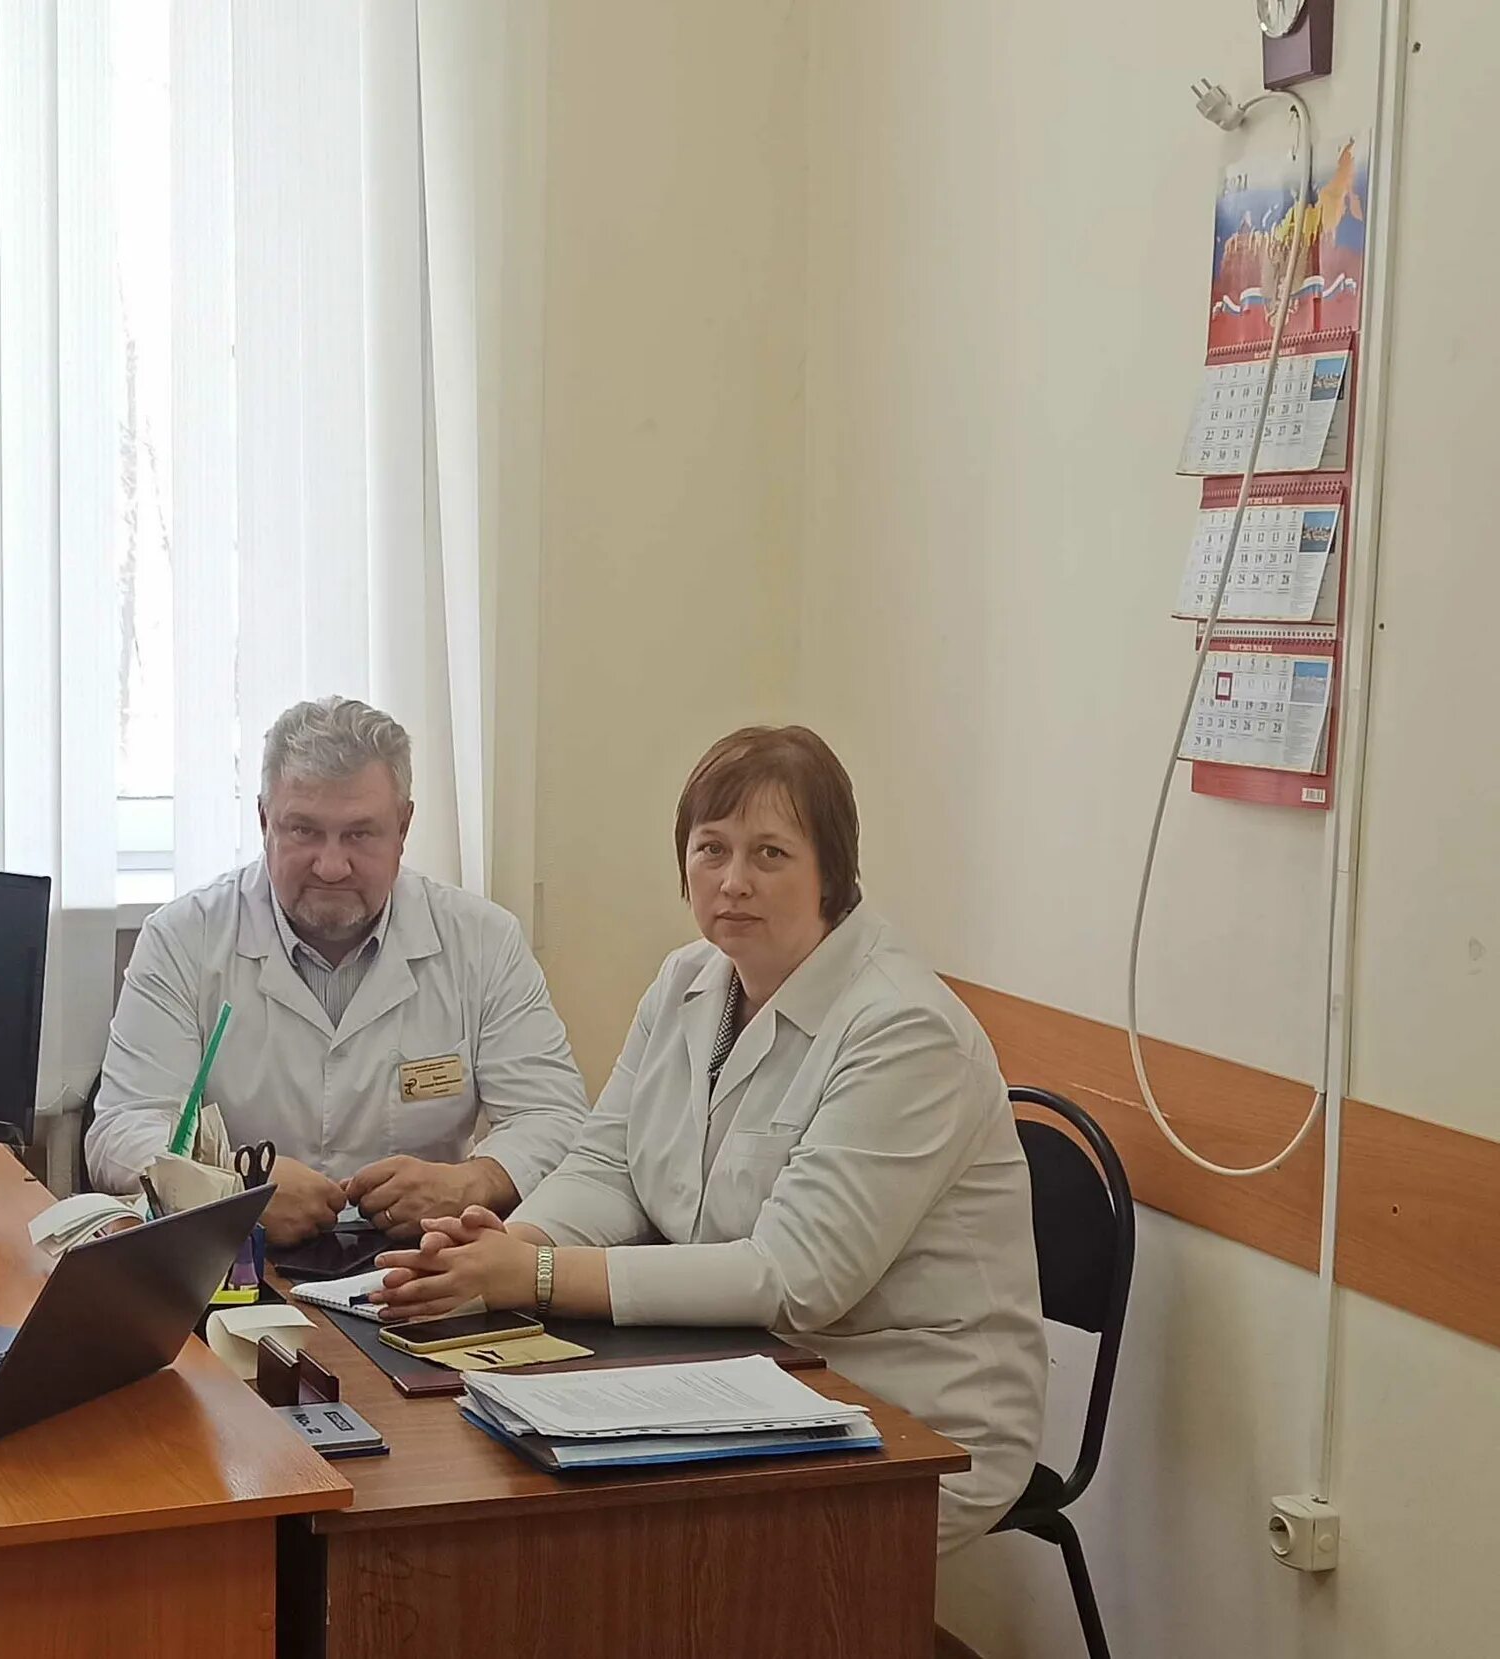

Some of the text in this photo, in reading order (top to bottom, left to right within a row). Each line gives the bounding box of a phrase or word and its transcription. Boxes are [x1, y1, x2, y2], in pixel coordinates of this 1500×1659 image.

[1205, 431, 1214, 440] 22
[1222, 430, 1230, 439] 23
[1287, 532, 1295, 542] 14
[1284, 553, 1292, 563] 21
[1232, 700, 1238, 709] 18
[1246, 701, 1253, 710] 19
[1260, 701, 1267, 710] 20
[1276, 702, 1283, 712] 21
[1230, 719, 1237, 729] 25
[1244, 720, 1251, 730] 26
[1273, 722, 1282, 733] 28
[307, 1427, 322, 1435] 2
